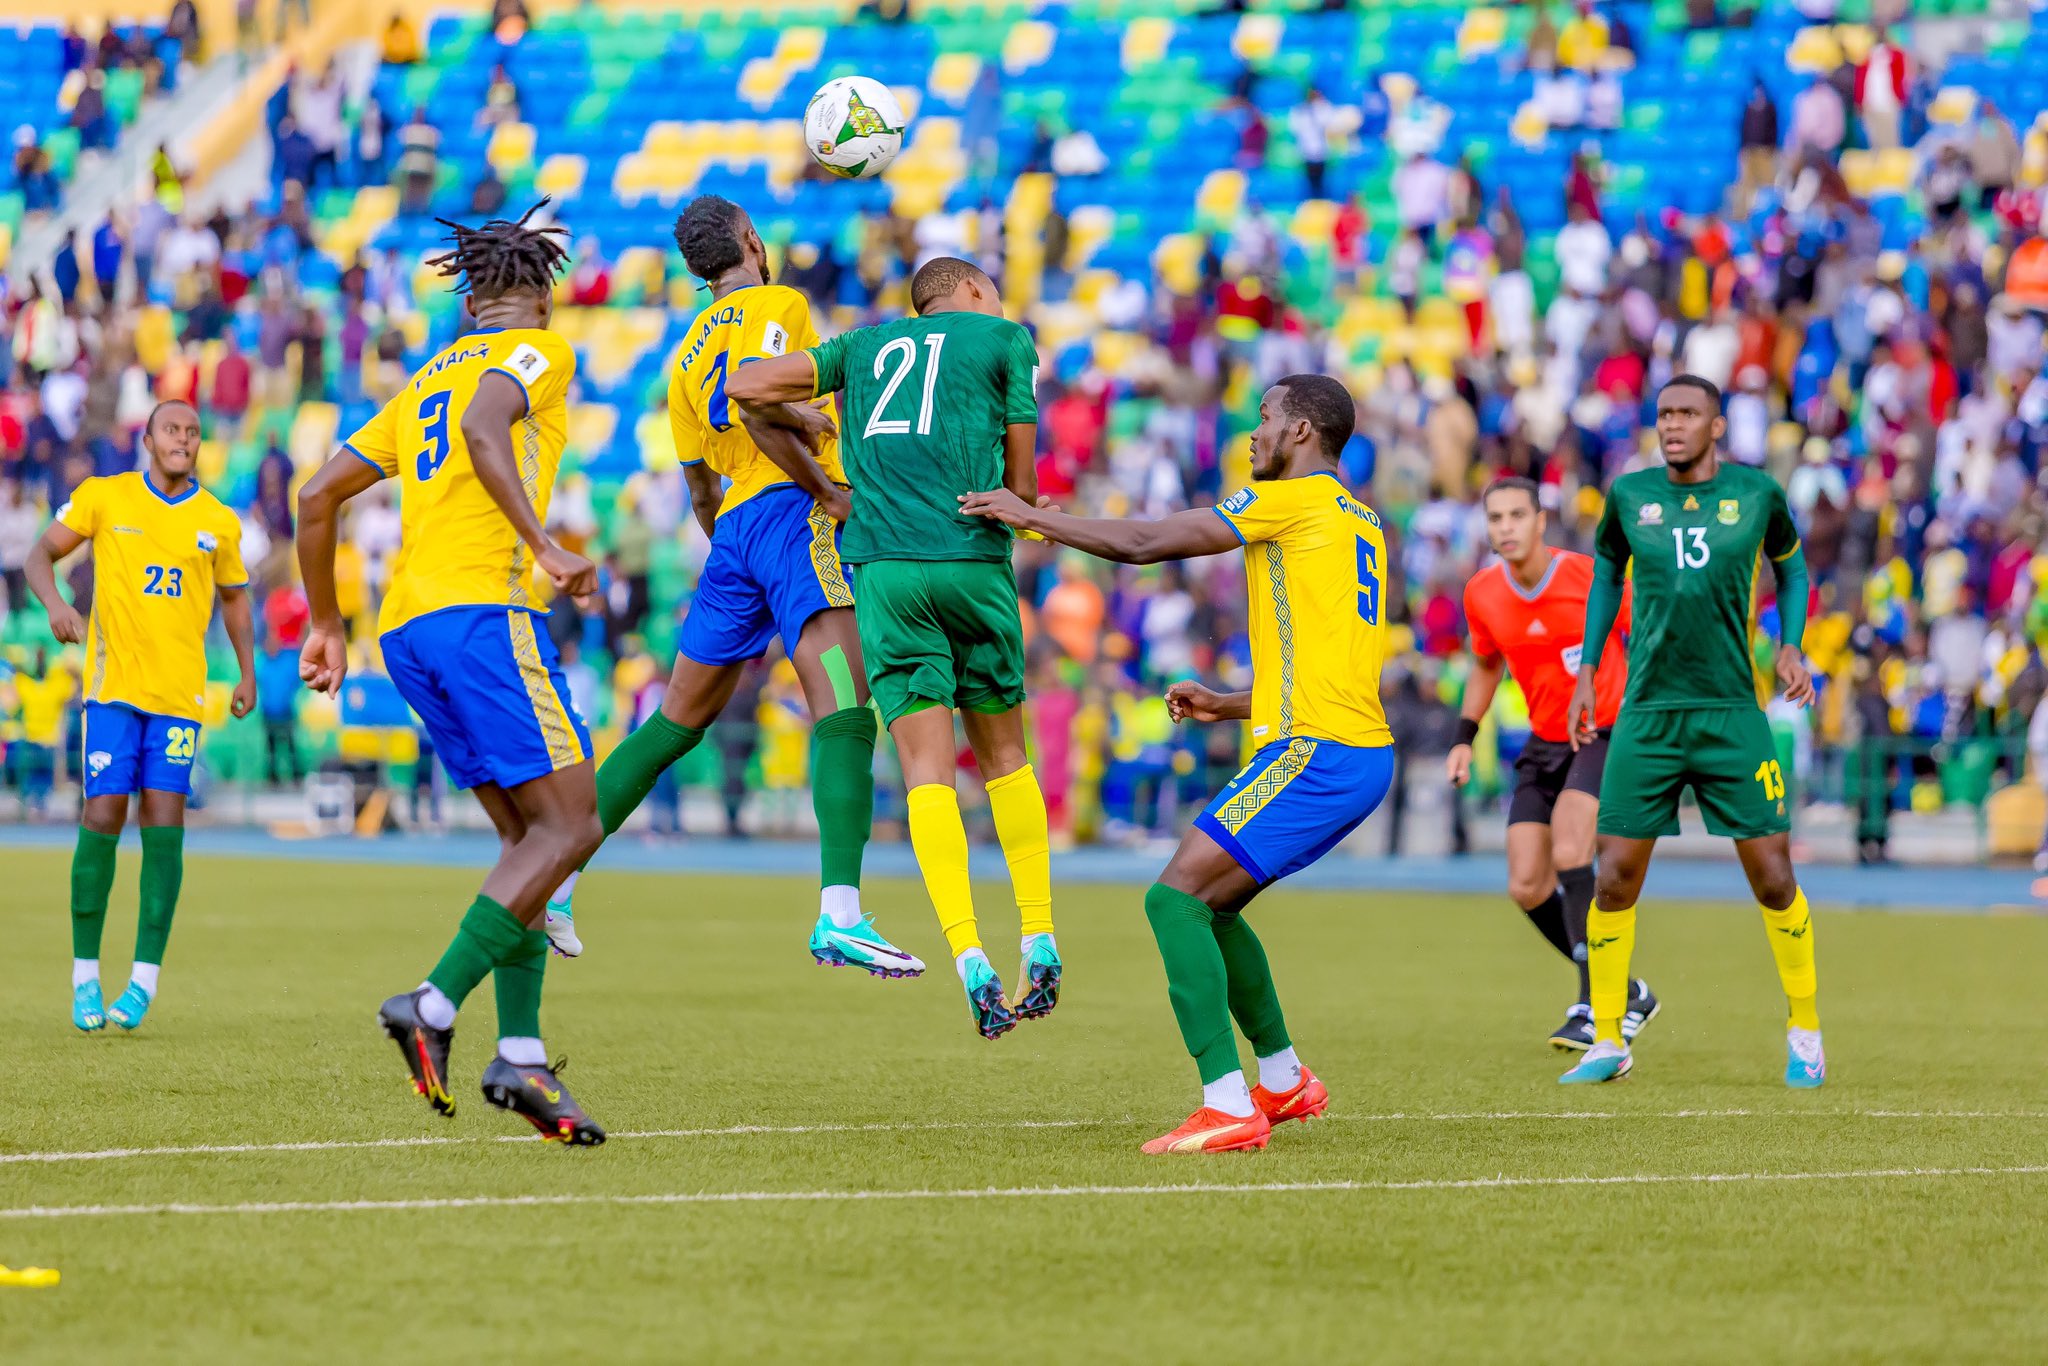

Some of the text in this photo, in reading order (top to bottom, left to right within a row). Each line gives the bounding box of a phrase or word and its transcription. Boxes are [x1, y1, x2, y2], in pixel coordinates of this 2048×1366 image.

[680, 306, 744, 372] RWANDA
[863, 333, 946, 439] 21
[417, 389, 453, 482] 3
[1671, 526, 1711, 570] 13
[143, 564, 183, 598] 23
[1355, 532, 1380, 626] 5
[165, 726, 195, 758] 23
[1755, 759, 1785, 801] 13
